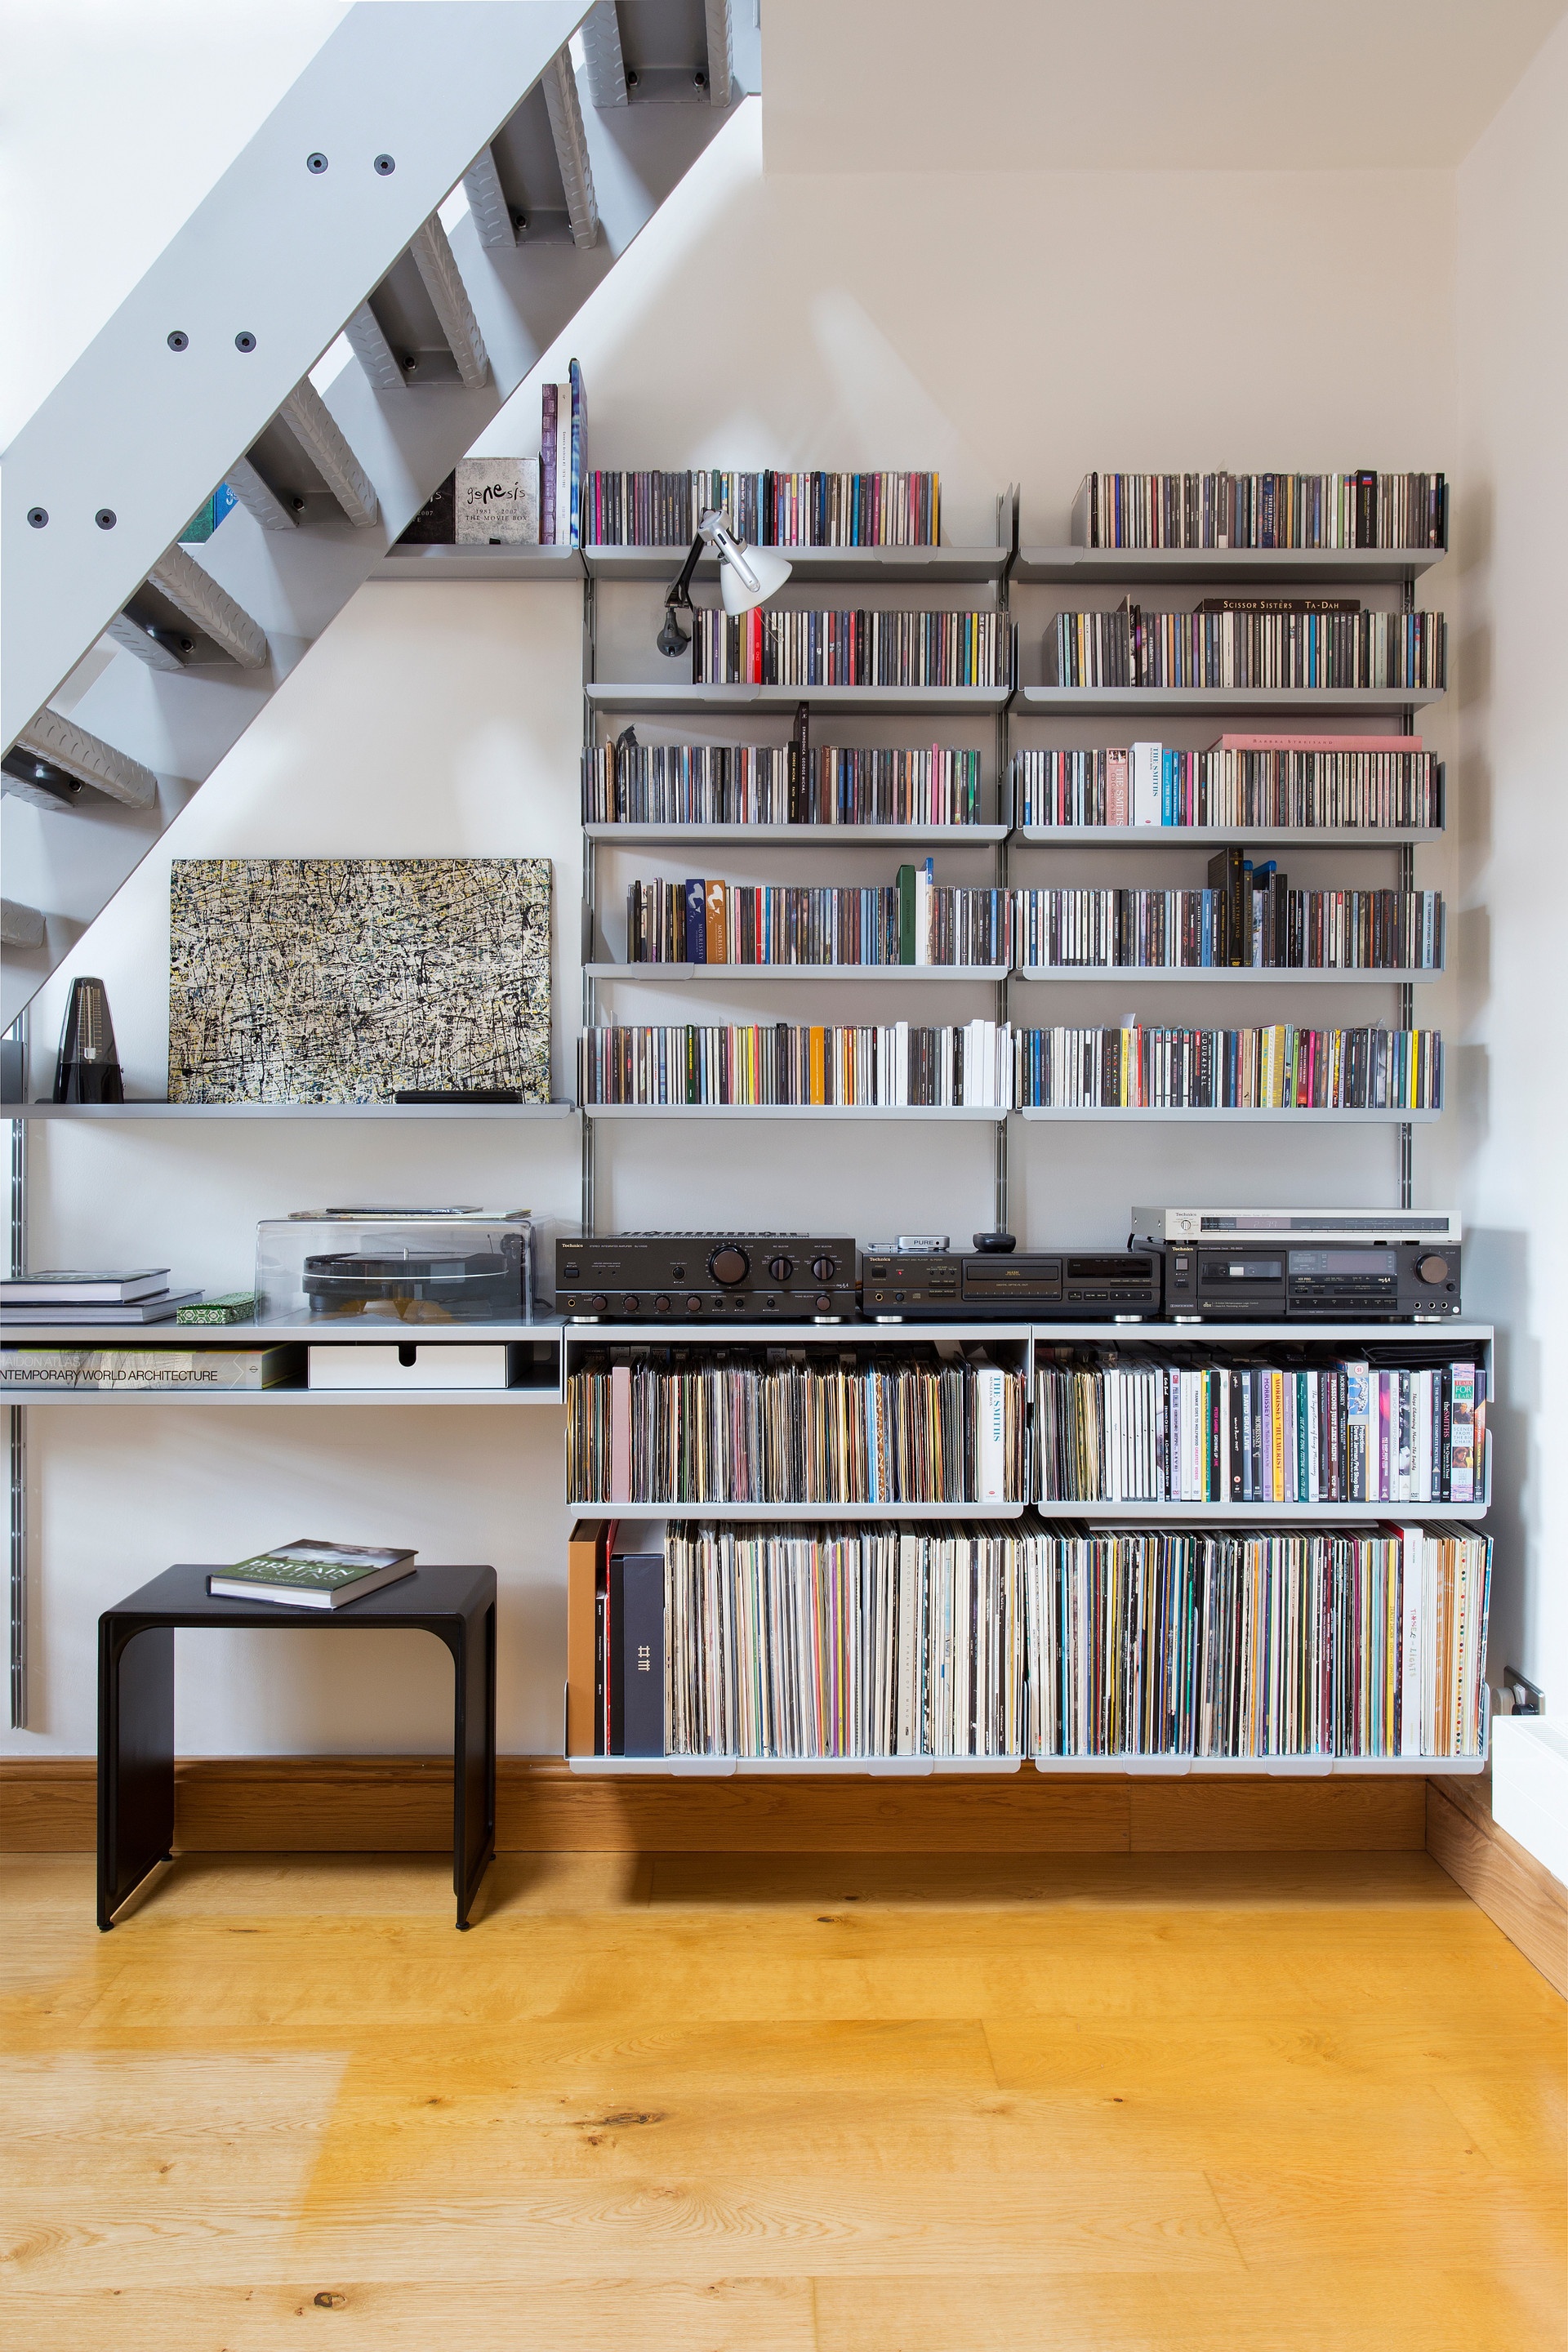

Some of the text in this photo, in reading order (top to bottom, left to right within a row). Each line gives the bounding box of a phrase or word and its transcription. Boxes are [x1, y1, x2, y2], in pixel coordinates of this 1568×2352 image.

[467, 482, 526, 504] genesis
[1116, 767, 1124, 826] THE SMITHS
[46, 1357, 80, 1367] ATLAS
[82, 1370, 126, 1380] WORLD
[129, 1370, 218, 1380] ARCHITECTURE
[238, 1565, 343, 1581] BEGINS
[249, 1560, 354, 1576] BRITAIN
